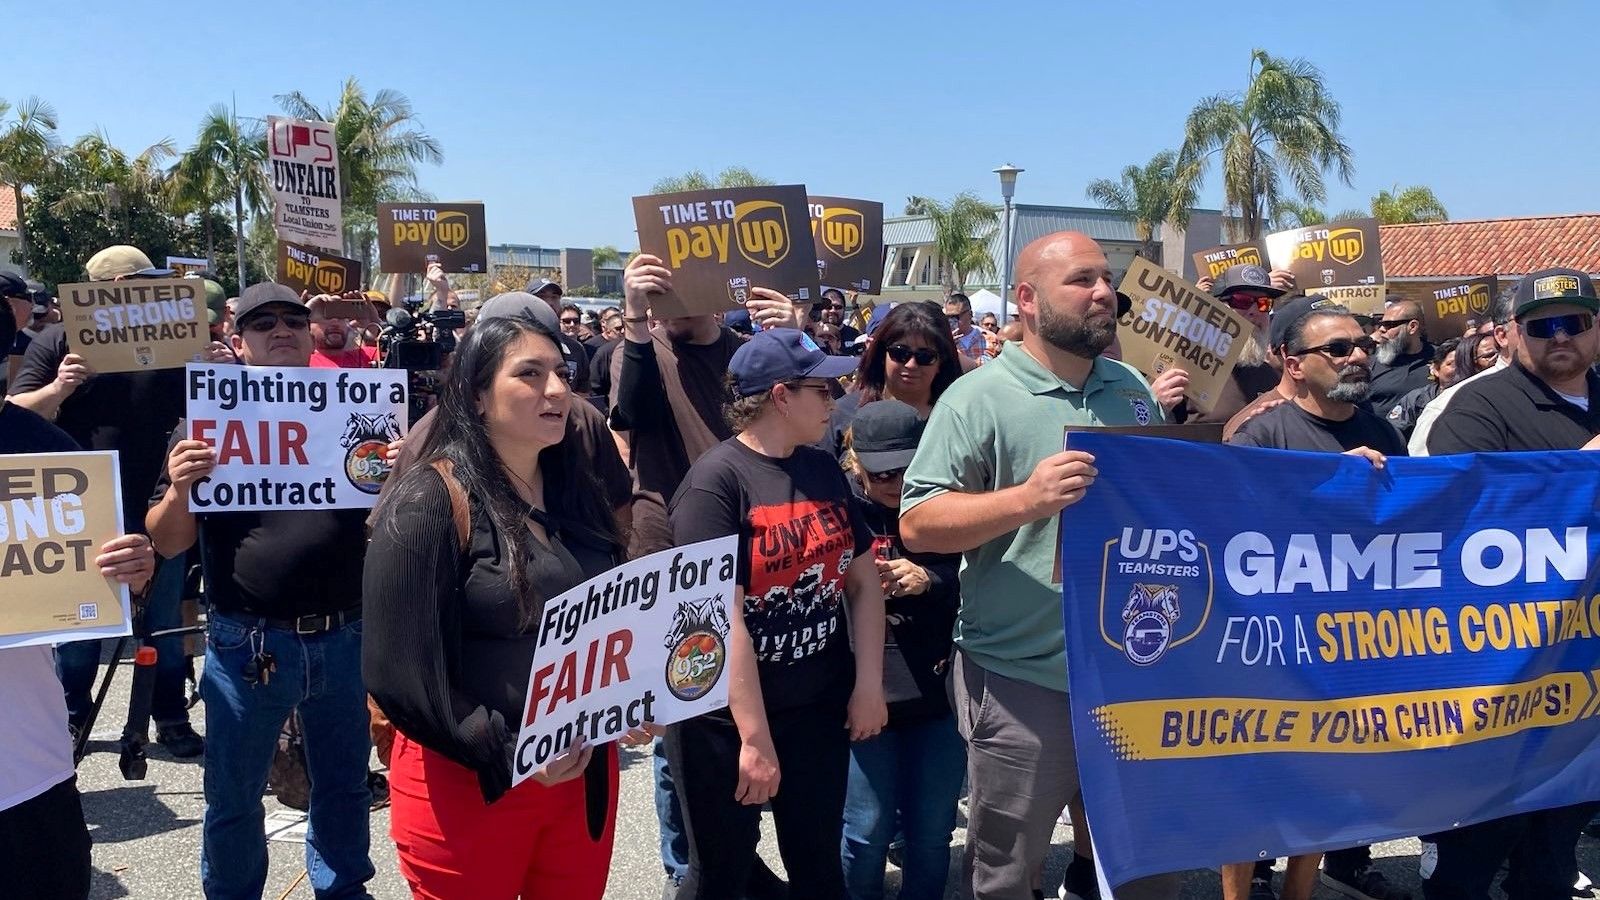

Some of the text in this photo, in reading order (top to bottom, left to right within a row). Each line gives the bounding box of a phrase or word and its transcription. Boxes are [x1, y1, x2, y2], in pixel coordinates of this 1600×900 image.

[272, 122, 332, 163] UPS
[273, 159, 338, 199] UNFAIR
[285, 203, 330, 219] TEAMSTERS
[301, 196, 311, 205] TO
[391, 209, 437, 221] TIME TO
[659, 199, 736, 225] TIME TO
[283, 213, 301, 226] Local
[302, 217, 324, 230] Union
[394, 222, 466, 246] pay up
[827, 221, 859, 253] up
[1314, 229, 1328, 240] TO
[286, 245, 320, 267] TIME TO
[666, 220, 784, 269] pay up
[1204, 248, 1237, 263] TIME TO
[1332, 238, 1360, 261] up
[287, 258, 342, 293] pay up
[730, 277, 747, 285] UPS
[1537, 281, 1578, 292] TEAMSTERS
[71, 284, 195, 308] UNITED
[1138, 268, 1241, 339] UNITED
[1433, 284, 1471, 300] TIME TO
[1437, 292, 1488, 319] pay up
[93, 297, 196, 332] STRONG
[1142, 298, 1233, 358] STRONG
[78, 322, 199, 346] CONTRACT
[1117, 309, 1225, 377] CONTRACT
[190, 369, 405, 412] Fighting for a
[192, 419, 310, 466] FAIR
[190, 475, 336, 507] Contract
[1120, 527, 1199, 562] UPS
[764, 555, 793, 574] WE
[1118, 562, 1200, 578] TEAMSTERS
[1224, 526, 1588, 597] GAME ON
[540, 552, 734, 648] Fighting for a
[757, 616, 837, 652] IVIDED
[793, 638, 827, 659] BEG
[1216, 615, 1287, 666] FOR
[1294, 614, 1313, 665] A
[1316, 607, 1452, 663] STRONG
[525, 628, 634, 728] FAIR
[675, 652, 716, 686] 952
[1161, 683, 1571, 748] BUCKLE YOUR CHIN STRAPS!
[516, 690, 656, 776] Contract
